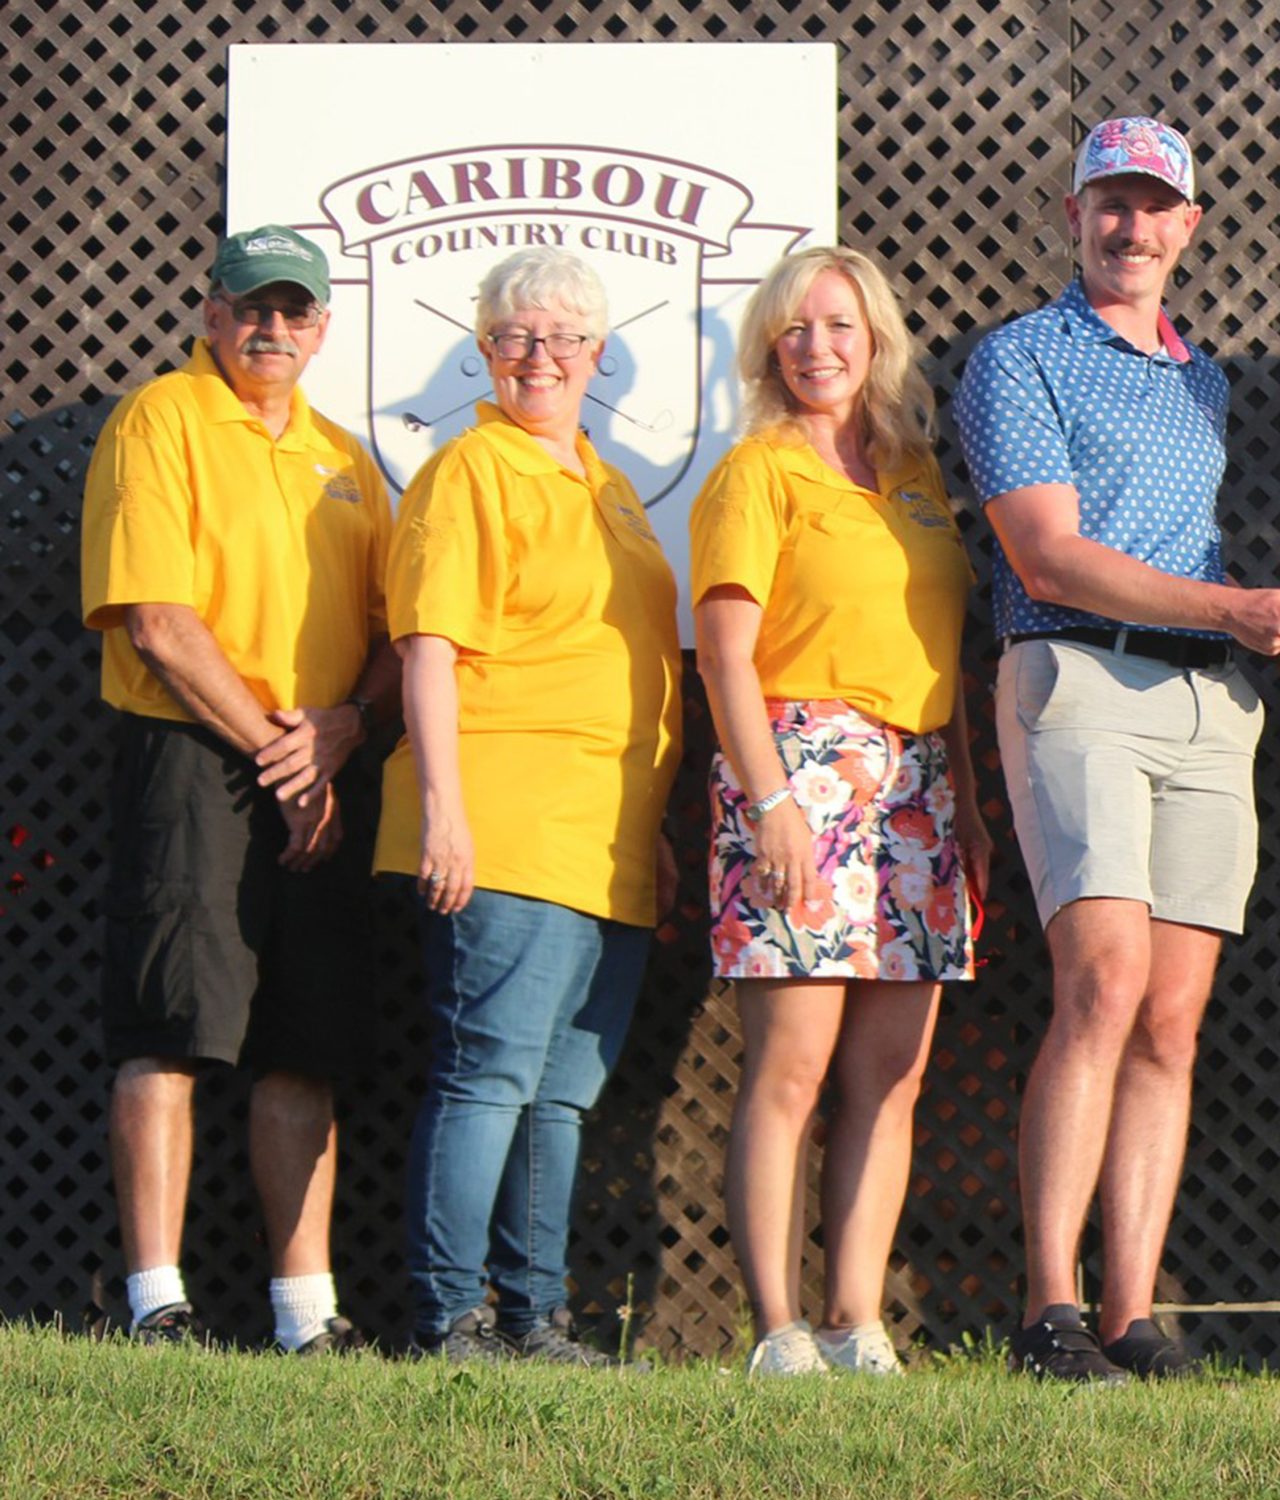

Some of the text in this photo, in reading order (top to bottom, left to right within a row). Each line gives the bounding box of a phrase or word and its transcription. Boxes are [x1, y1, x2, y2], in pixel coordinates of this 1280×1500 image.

[355, 156, 711, 228] CARIBOU
[390, 223, 678, 266] COUNTRY CLUB
